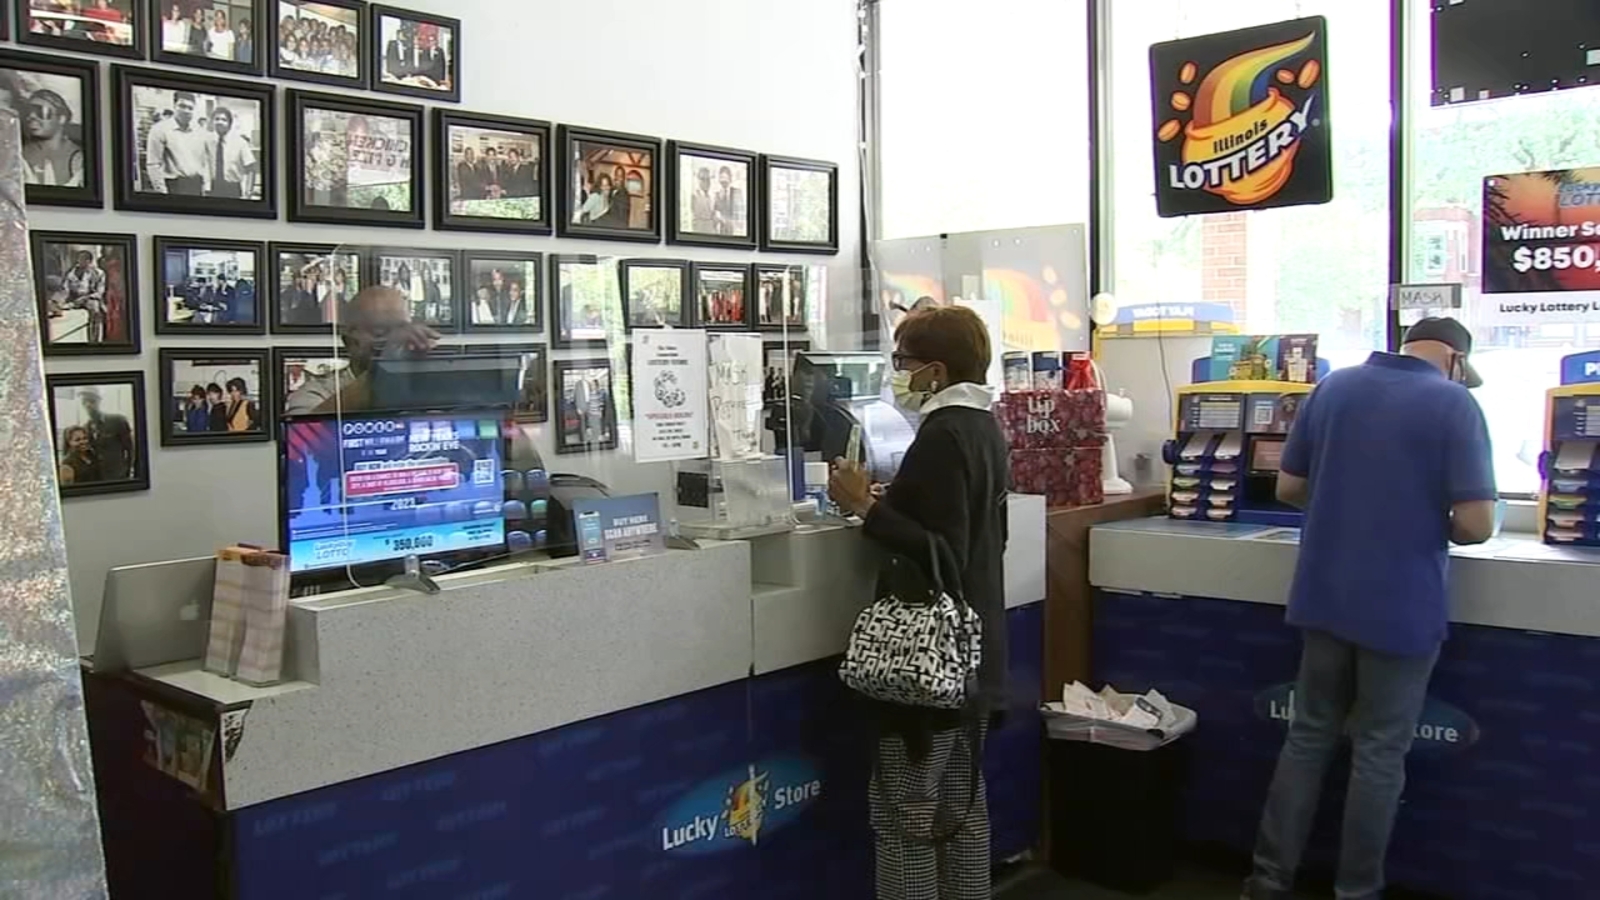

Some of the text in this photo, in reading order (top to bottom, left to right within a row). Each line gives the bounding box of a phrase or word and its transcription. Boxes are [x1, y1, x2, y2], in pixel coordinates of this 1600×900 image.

[1169, 94, 1315, 189] LOTTERY
[1213, 119, 1268, 154] Illinois
[1501, 223, 1578, 241] Winner
[1500, 303, 1537, 314] Lucky
[1540, 303, 1590, 314] Lottery
[393, 535, 434, 551] 350,000
[774, 780, 821, 810] Store
[662, 814, 719, 850] Lucky
